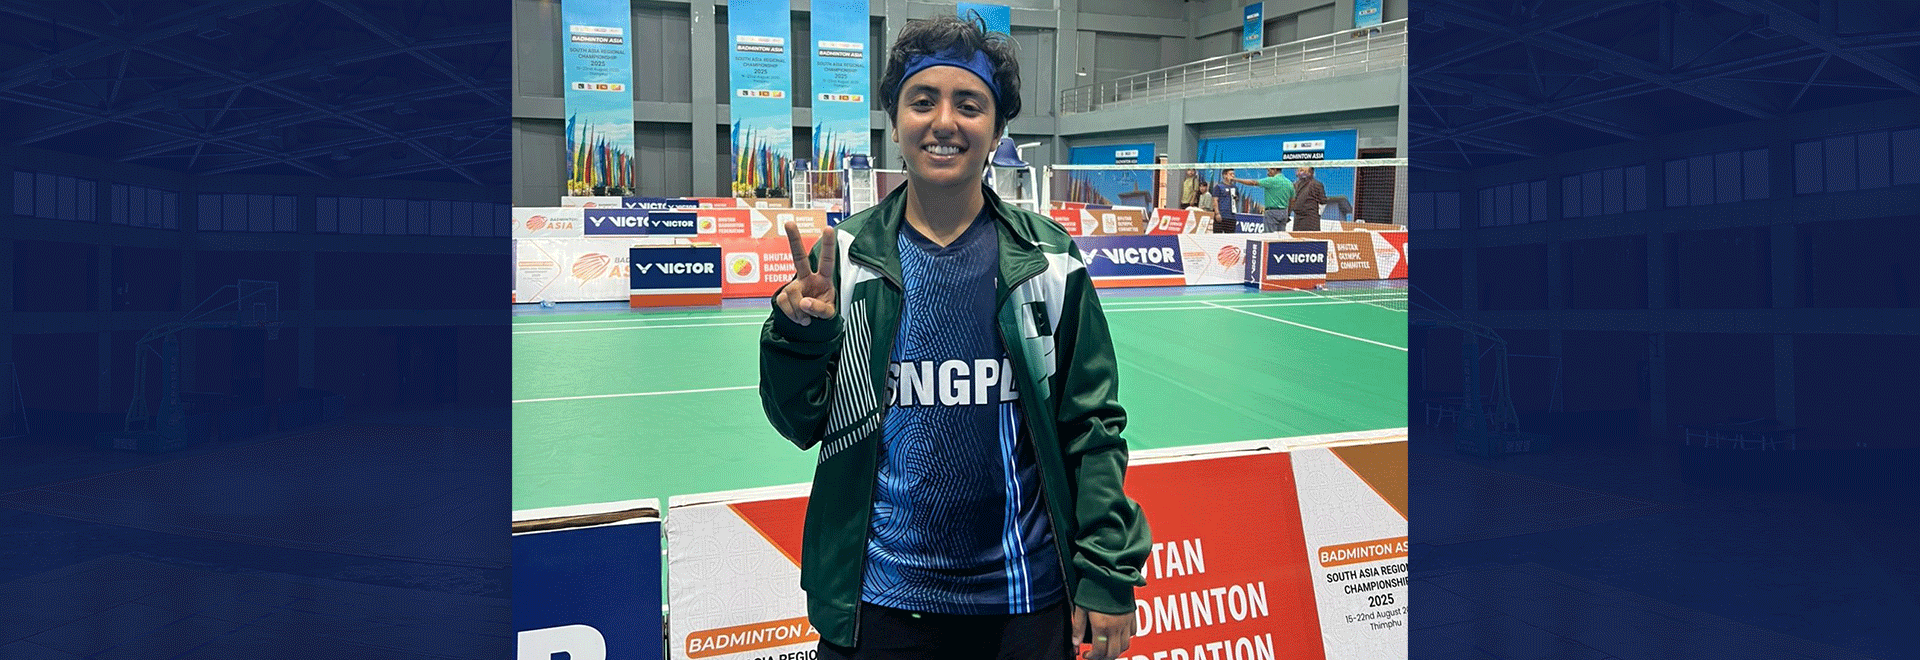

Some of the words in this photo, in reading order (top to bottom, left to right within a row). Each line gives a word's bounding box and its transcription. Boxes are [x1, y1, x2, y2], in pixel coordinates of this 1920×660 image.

[571, 35, 608, 43] BADMINTON
[737, 44, 769, 52] BADMINTON
[819, 49, 849, 57] BADMINTON
[547, 222, 574, 230] ASIA
[661, 220, 694, 228] VICTOR
[1101, 247, 1176, 265] VICTOR
[1286, 253, 1324, 263] VICTOR
[656, 262, 715, 274] VICTOR
[1321, 543, 1392, 563] BADMINTON
[1327, 570, 1357, 583] SOUTH
[1360, 567, 1380, 579] ASIA
[1368, 593, 1394, 607] 2025
[1345, 612, 1375, 623] 15-22nd
[1377, 608, 1401, 619] August
[1370, 619, 1402, 631] Thimphu
[689, 623, 802, 653] BADMINTON
